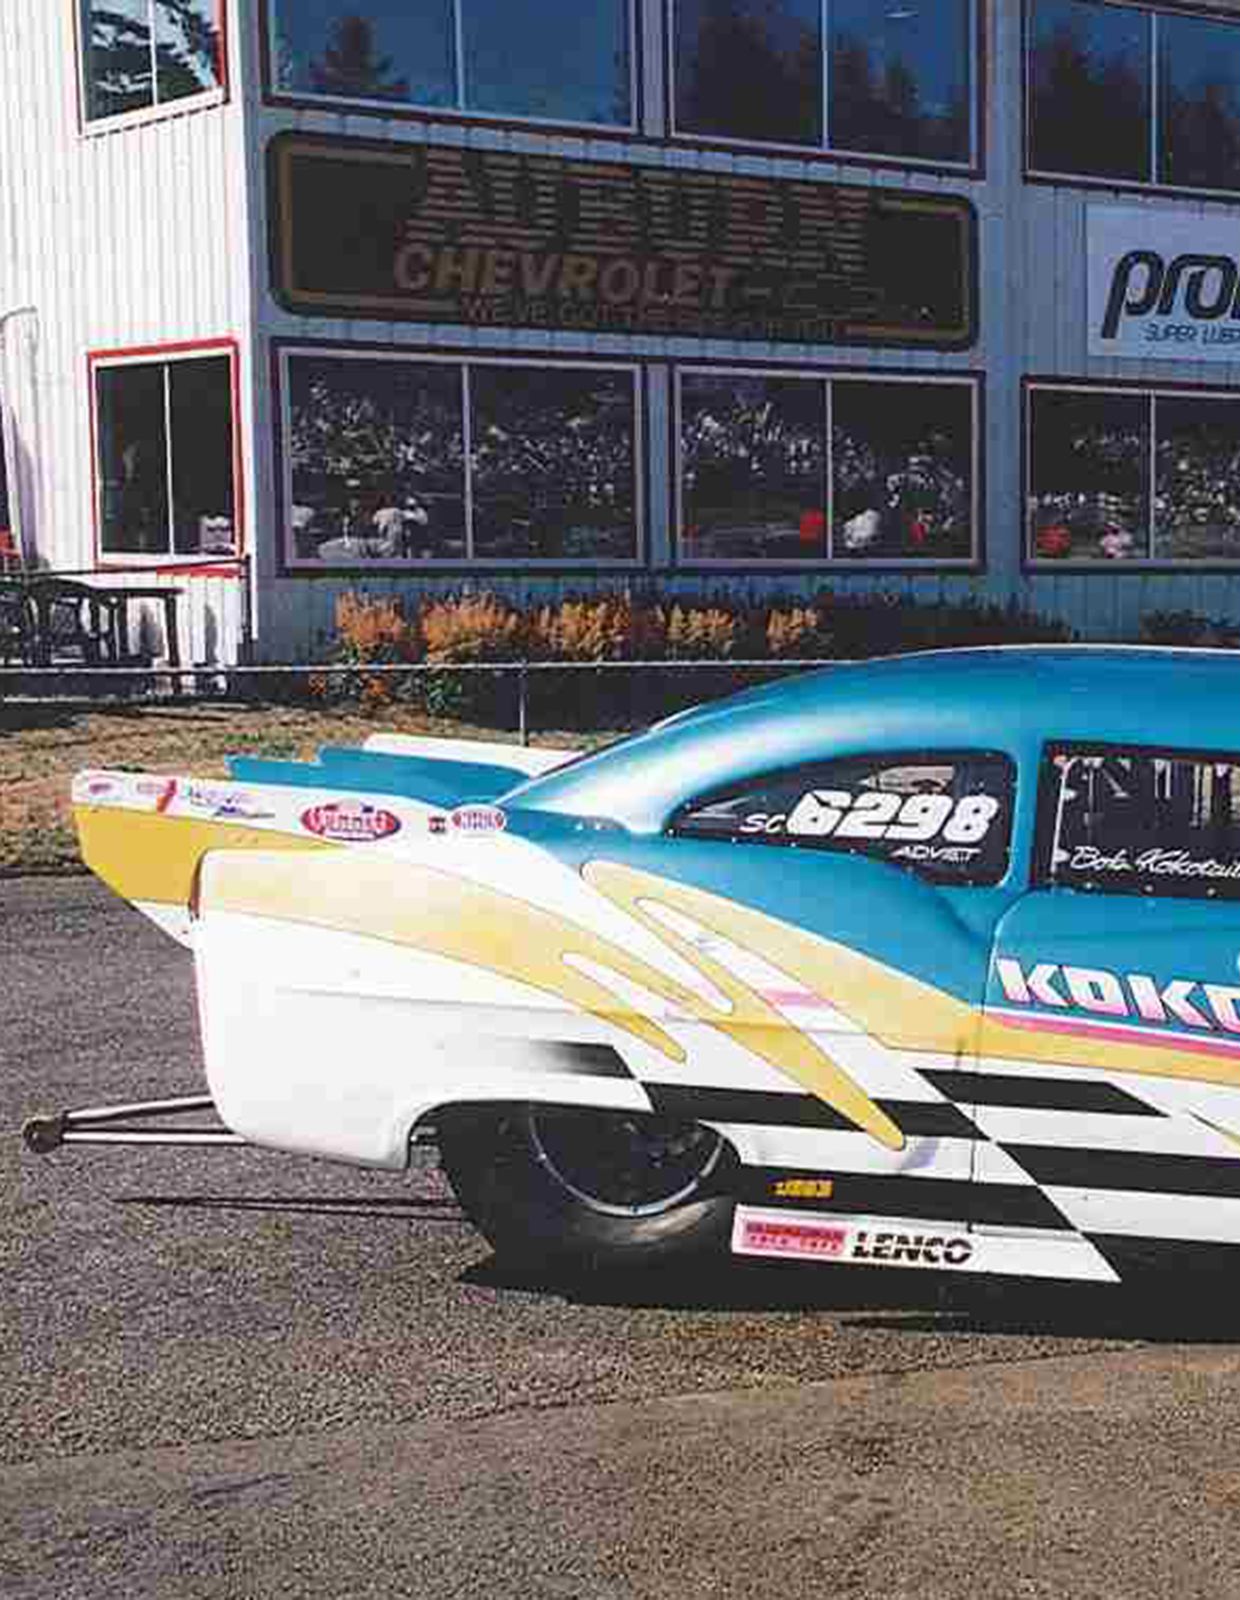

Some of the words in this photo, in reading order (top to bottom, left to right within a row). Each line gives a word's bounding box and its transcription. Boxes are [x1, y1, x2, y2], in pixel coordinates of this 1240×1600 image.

[394, 245, 735, 308] CHEVROLET
[740, 812, 789, 834] SC
[786, 790, 999, 843] 6298
[852, 1231, 972, 1264] LENCO
